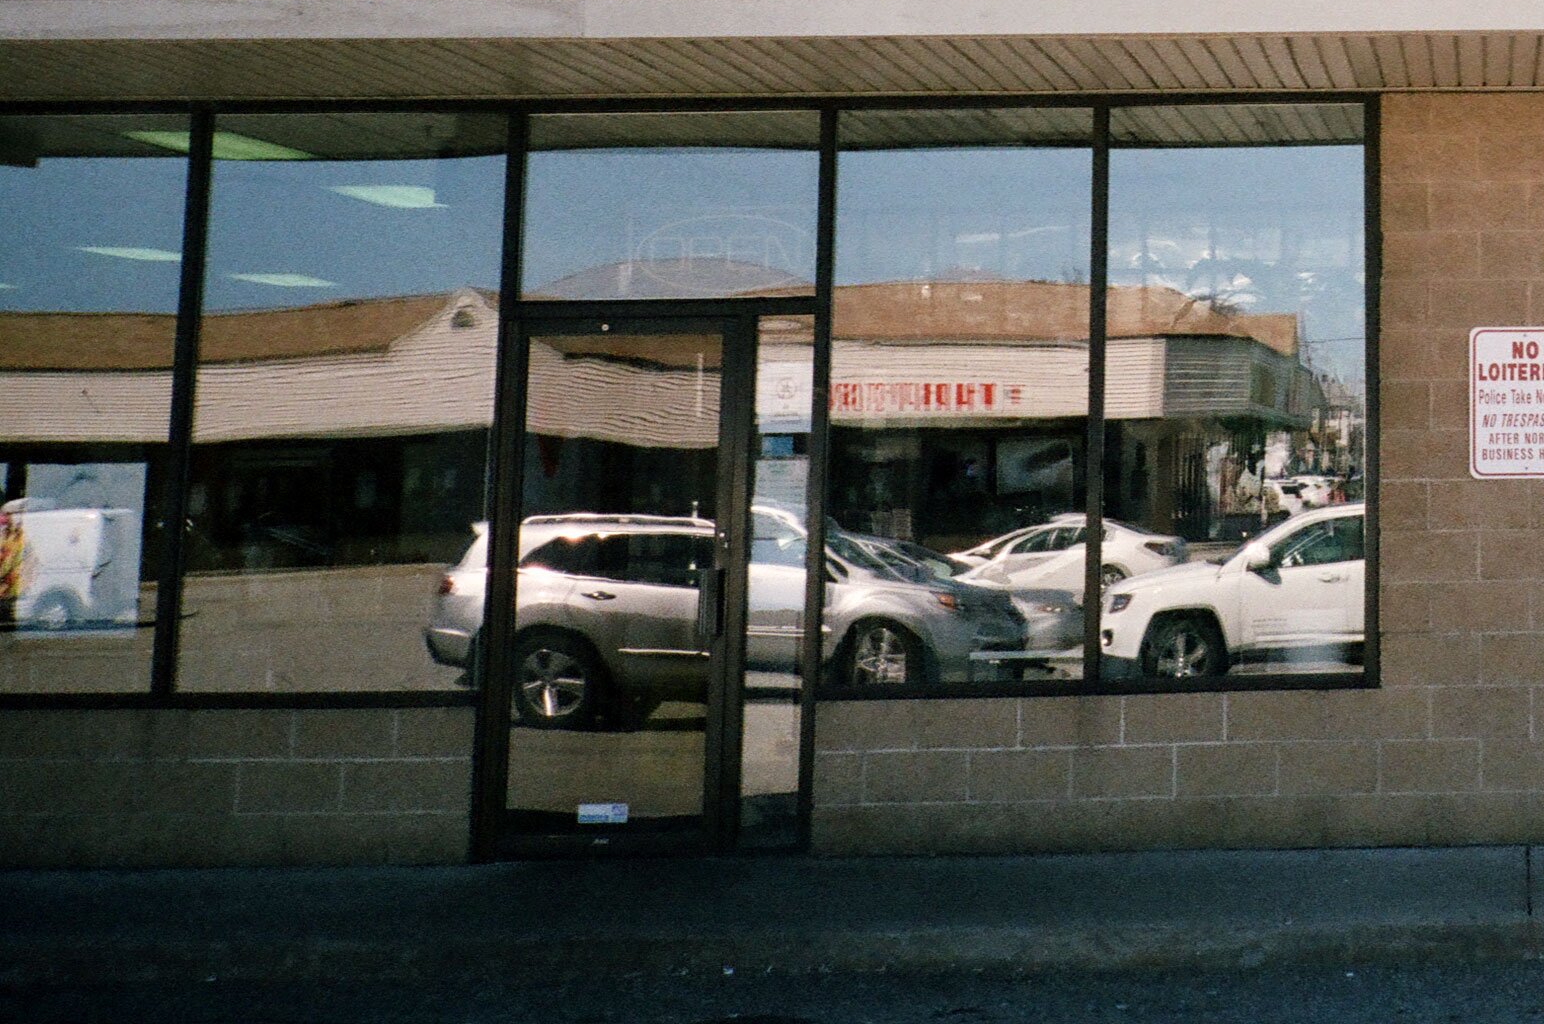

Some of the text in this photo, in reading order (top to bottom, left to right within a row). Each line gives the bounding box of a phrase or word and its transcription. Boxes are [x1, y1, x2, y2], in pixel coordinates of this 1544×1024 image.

[1512, 341, 1539, 359] NO
[1479, 389, 1506, 404] Police
[1510, 389, 1531, 404] Take
[1482, 414, 1497, 427] NO
[1489, 433, 1519, 444] AFTER
[1482, 448, 1534, 460] BUSINESS
